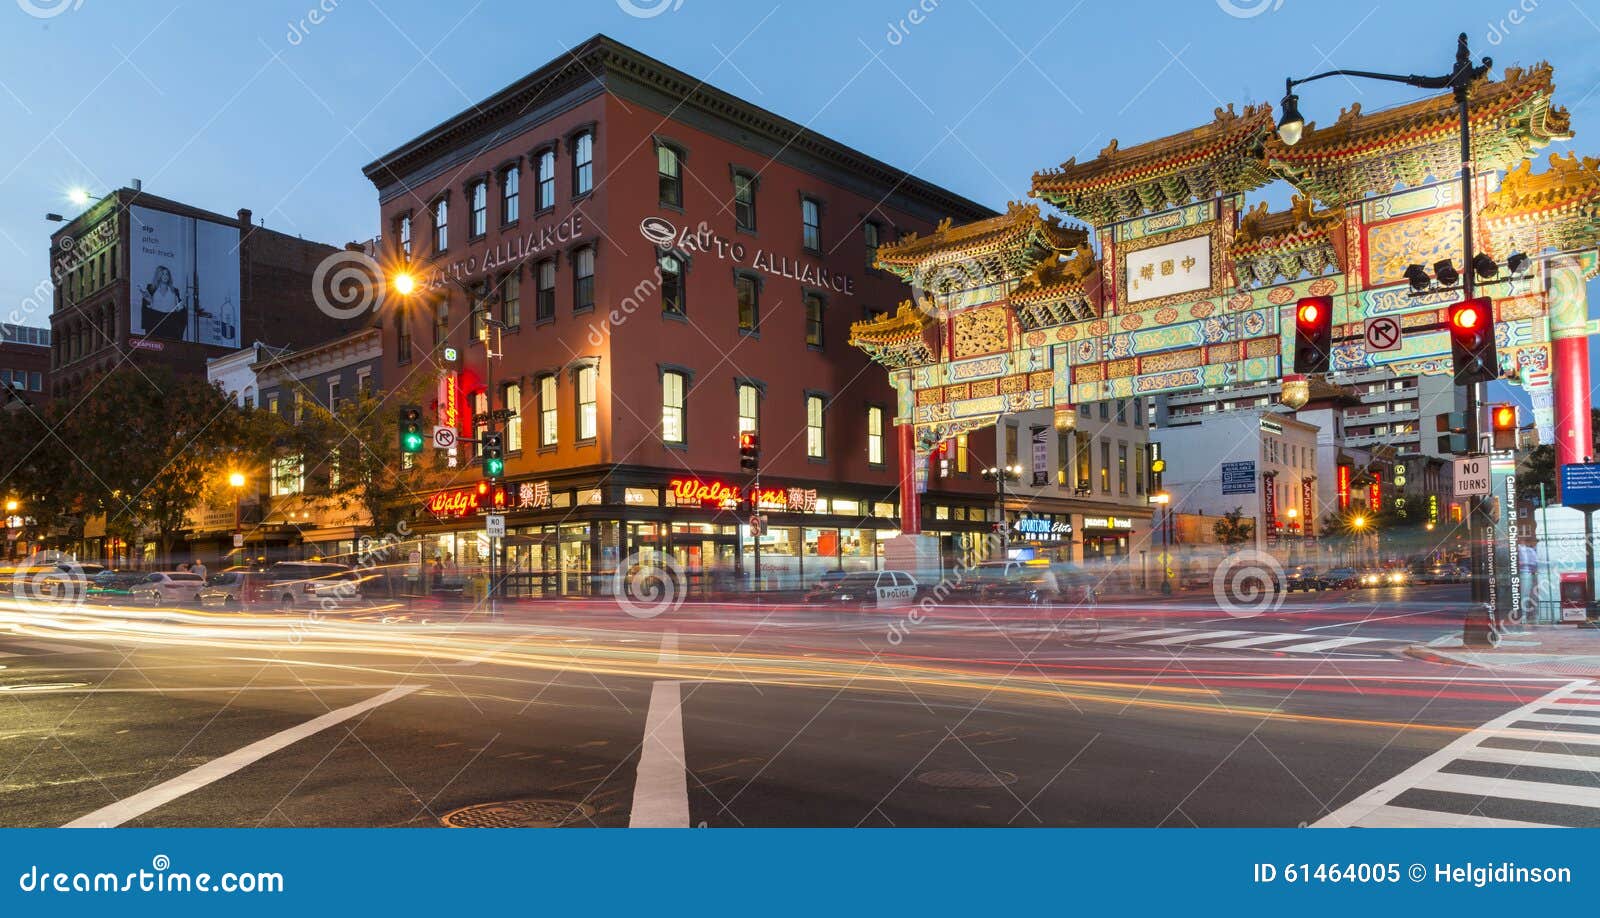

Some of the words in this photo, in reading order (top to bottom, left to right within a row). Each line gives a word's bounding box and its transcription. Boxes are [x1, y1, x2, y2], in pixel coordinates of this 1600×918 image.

[482, 216, 584, 272] ALLIANCE
[752, 249, 854, 296] ALLIANCE
[447, 376, 459, 428] algreens
[1458, 478, 1487, 491] TURNS
[1463, 462, 1479, 475] NO
[1506, 475, 1517, 509] Gallery
[1486, 526, 1495, 576] Chinatown
[886, 590, 910, 599] POLICE
[1488, 577, 1497, 611] Station
[1511, 577, 1520, 611] Station
